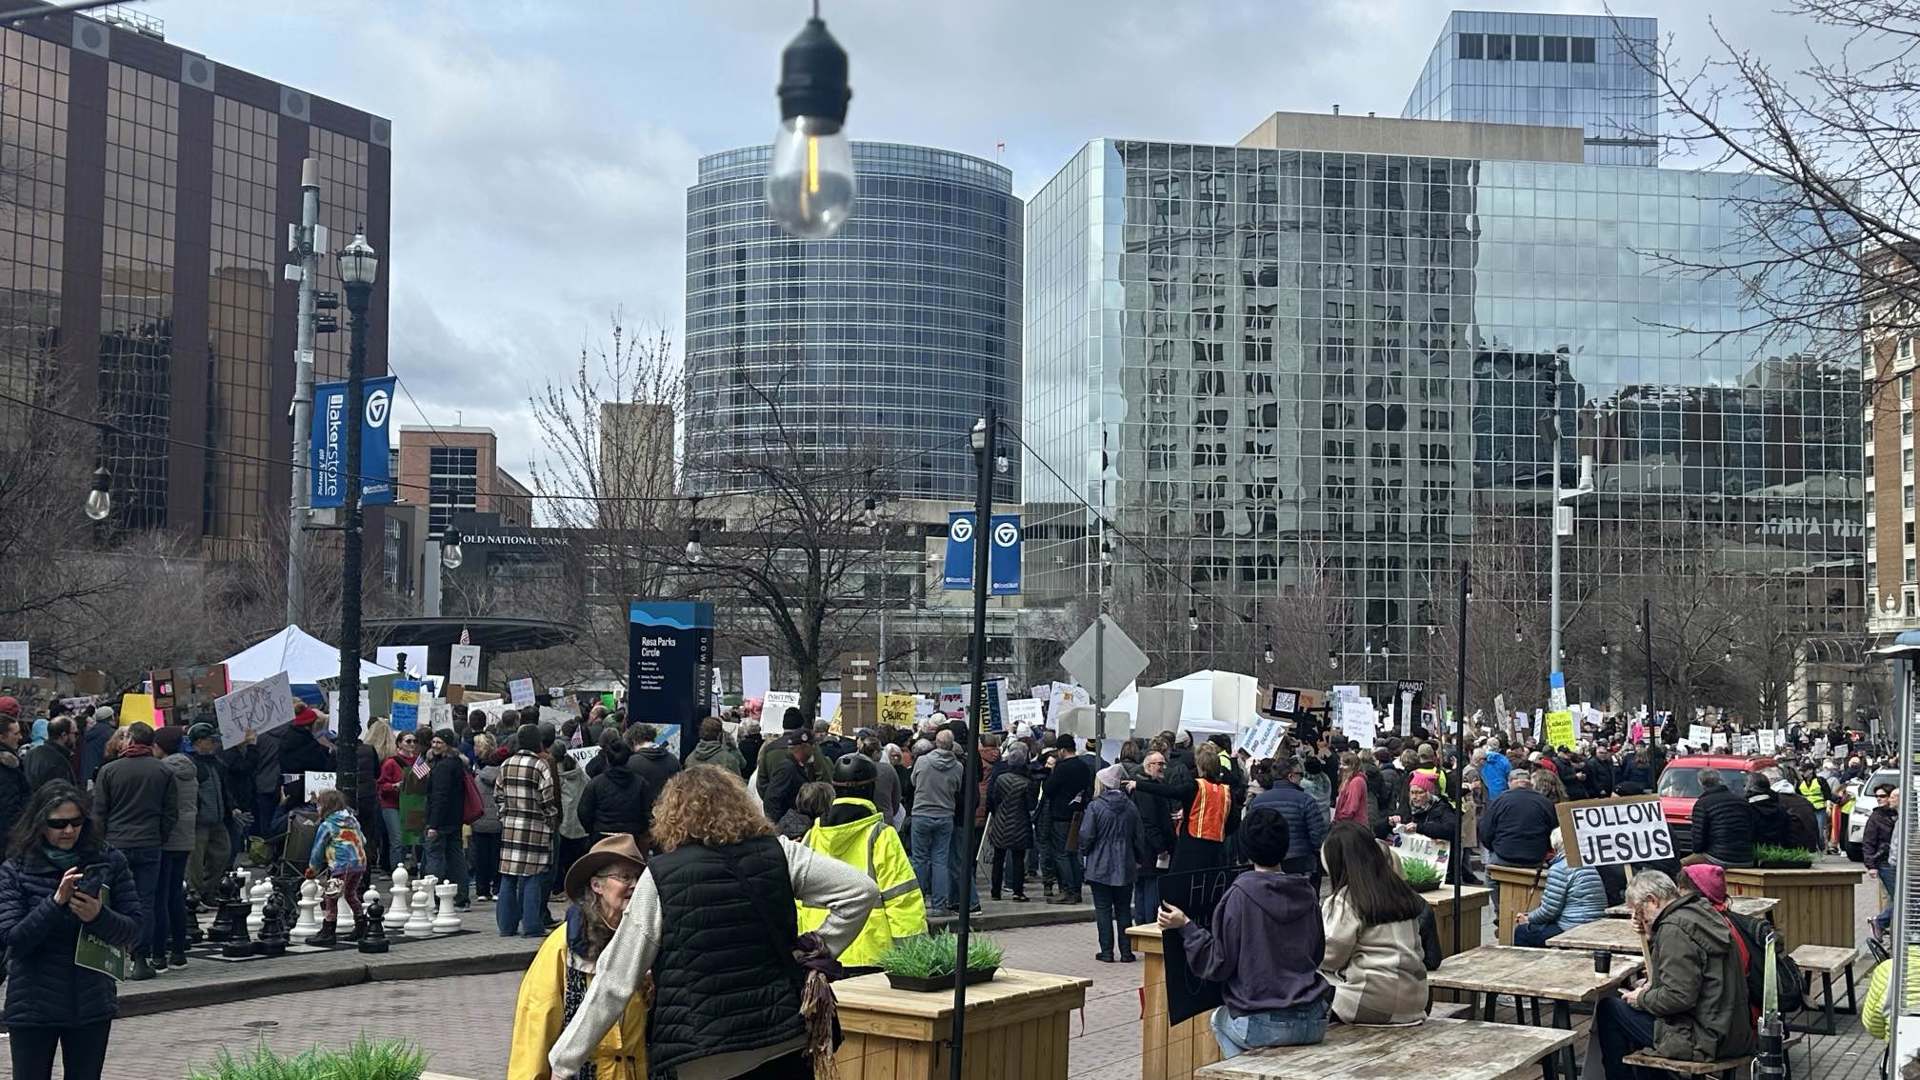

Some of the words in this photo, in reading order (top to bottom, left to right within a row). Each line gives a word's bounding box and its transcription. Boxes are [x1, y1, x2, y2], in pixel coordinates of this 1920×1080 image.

[463, 534, 485, 544] OLD
[487, 535, 538, 545] NATIONAL
[641, 636, 657, 647] Rosa
[658, 636, 676, 647] Parks
[641, 647, 660, 657] Circle
[459, 655, 474, 669] 47
[698, 637, 708, 706] DOWNTOWN
[231, 695, 287, 731] TRUMP
[313, 773, 334, 781] USA
[1572, 802, 1662, 830] FOLLOW
[1582, 829, 1671, 865] JESUS
